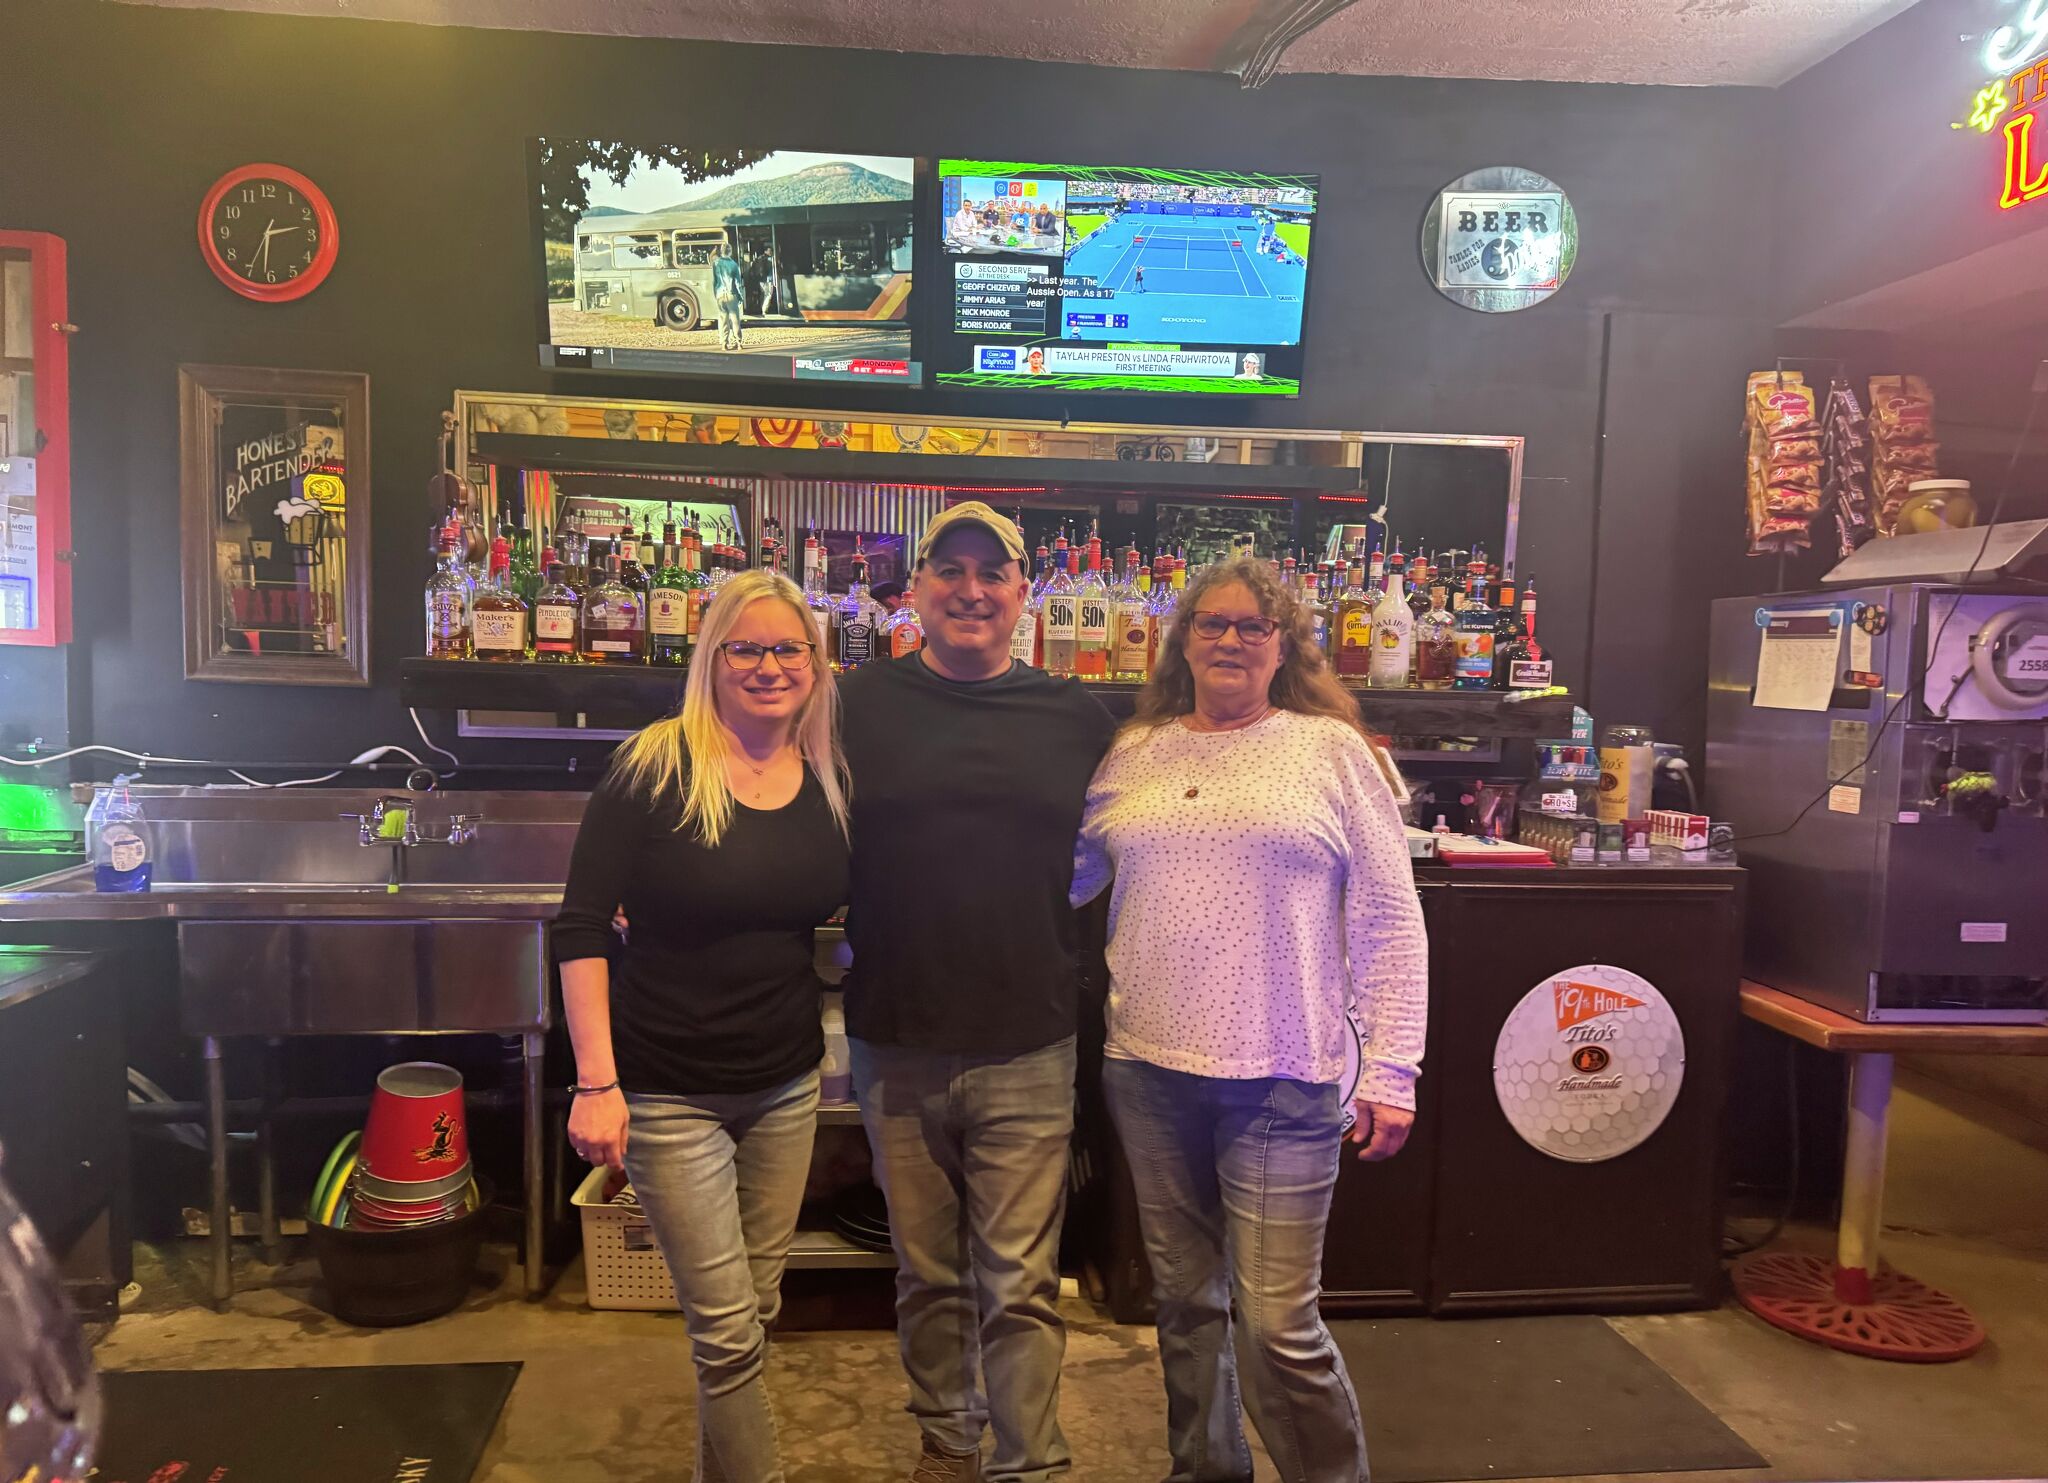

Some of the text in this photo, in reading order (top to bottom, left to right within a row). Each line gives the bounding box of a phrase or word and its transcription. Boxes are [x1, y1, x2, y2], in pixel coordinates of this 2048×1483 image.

[242, 189, 256, 203] 11
[261, 184, 276, 198] 12
[288, 191, 294, 204] 1
[226, 205, 241, 219] 10
[302, 207, 311, 221] 2
[1458, 210, 1549, 233] BEER
[220, 225, 230, 239] 9
[307, 228, 317, 242] 3
[227, 247, 237, 261] 8
[303, 250, 311, 263] 4
[1448, 238, 1485, 265] TABLES FOR
[289, 264, 298, 278] 5
[978, 265, 1032, 274] SECOND SERVE
[1456, 255, 1480, 273] LADIES
[267, 270, 276, 284] 6
[1039, 276, 1058, 284] Last
[1059, 277, 1079, 286] year.
[1081, 277, 1098, 286] The
[962, 282, 1020, 292] GEOFF CHIZEVER
[1026, 287, 1055, 296] Aussie
[1057, 288, 1080, 298] Open.
[1083, 289, 1094, 297] As
[1104, 289, 1114, 298] 17
[962, 296, 1006, 304] JIMMY ARIAS
[1026, 299, 1044, 308] year
[961, 308, 1010, 317] NICK MONROE
[961, 321, 1012, 330] BORIS KODJOE
[560, 347, 586, 355] ESPN
[1055, 351, 1230, 364] TAYLAH PRESTON vs LINDA FRUHVIRTOVA
[1115, 363, 1172, 372] FIRST MEETING
[236, 420, 310, 471] HONEST
[226, 445, 334, 516] BARTENDER
[653, 591, 684, 602] AMESON
[476, 613, 514, 621] Maker's
[1050, 605, 1073, 626] SON
[1082, 607, 1105, 628] SON
[1600, 757, 1624, 770] ito's
[1594, 992, 1628, 1012] HOLE
[1565, 1024, 1617, 1043] Tito's
[1557, 1074, 1622, 1091] Handmade
